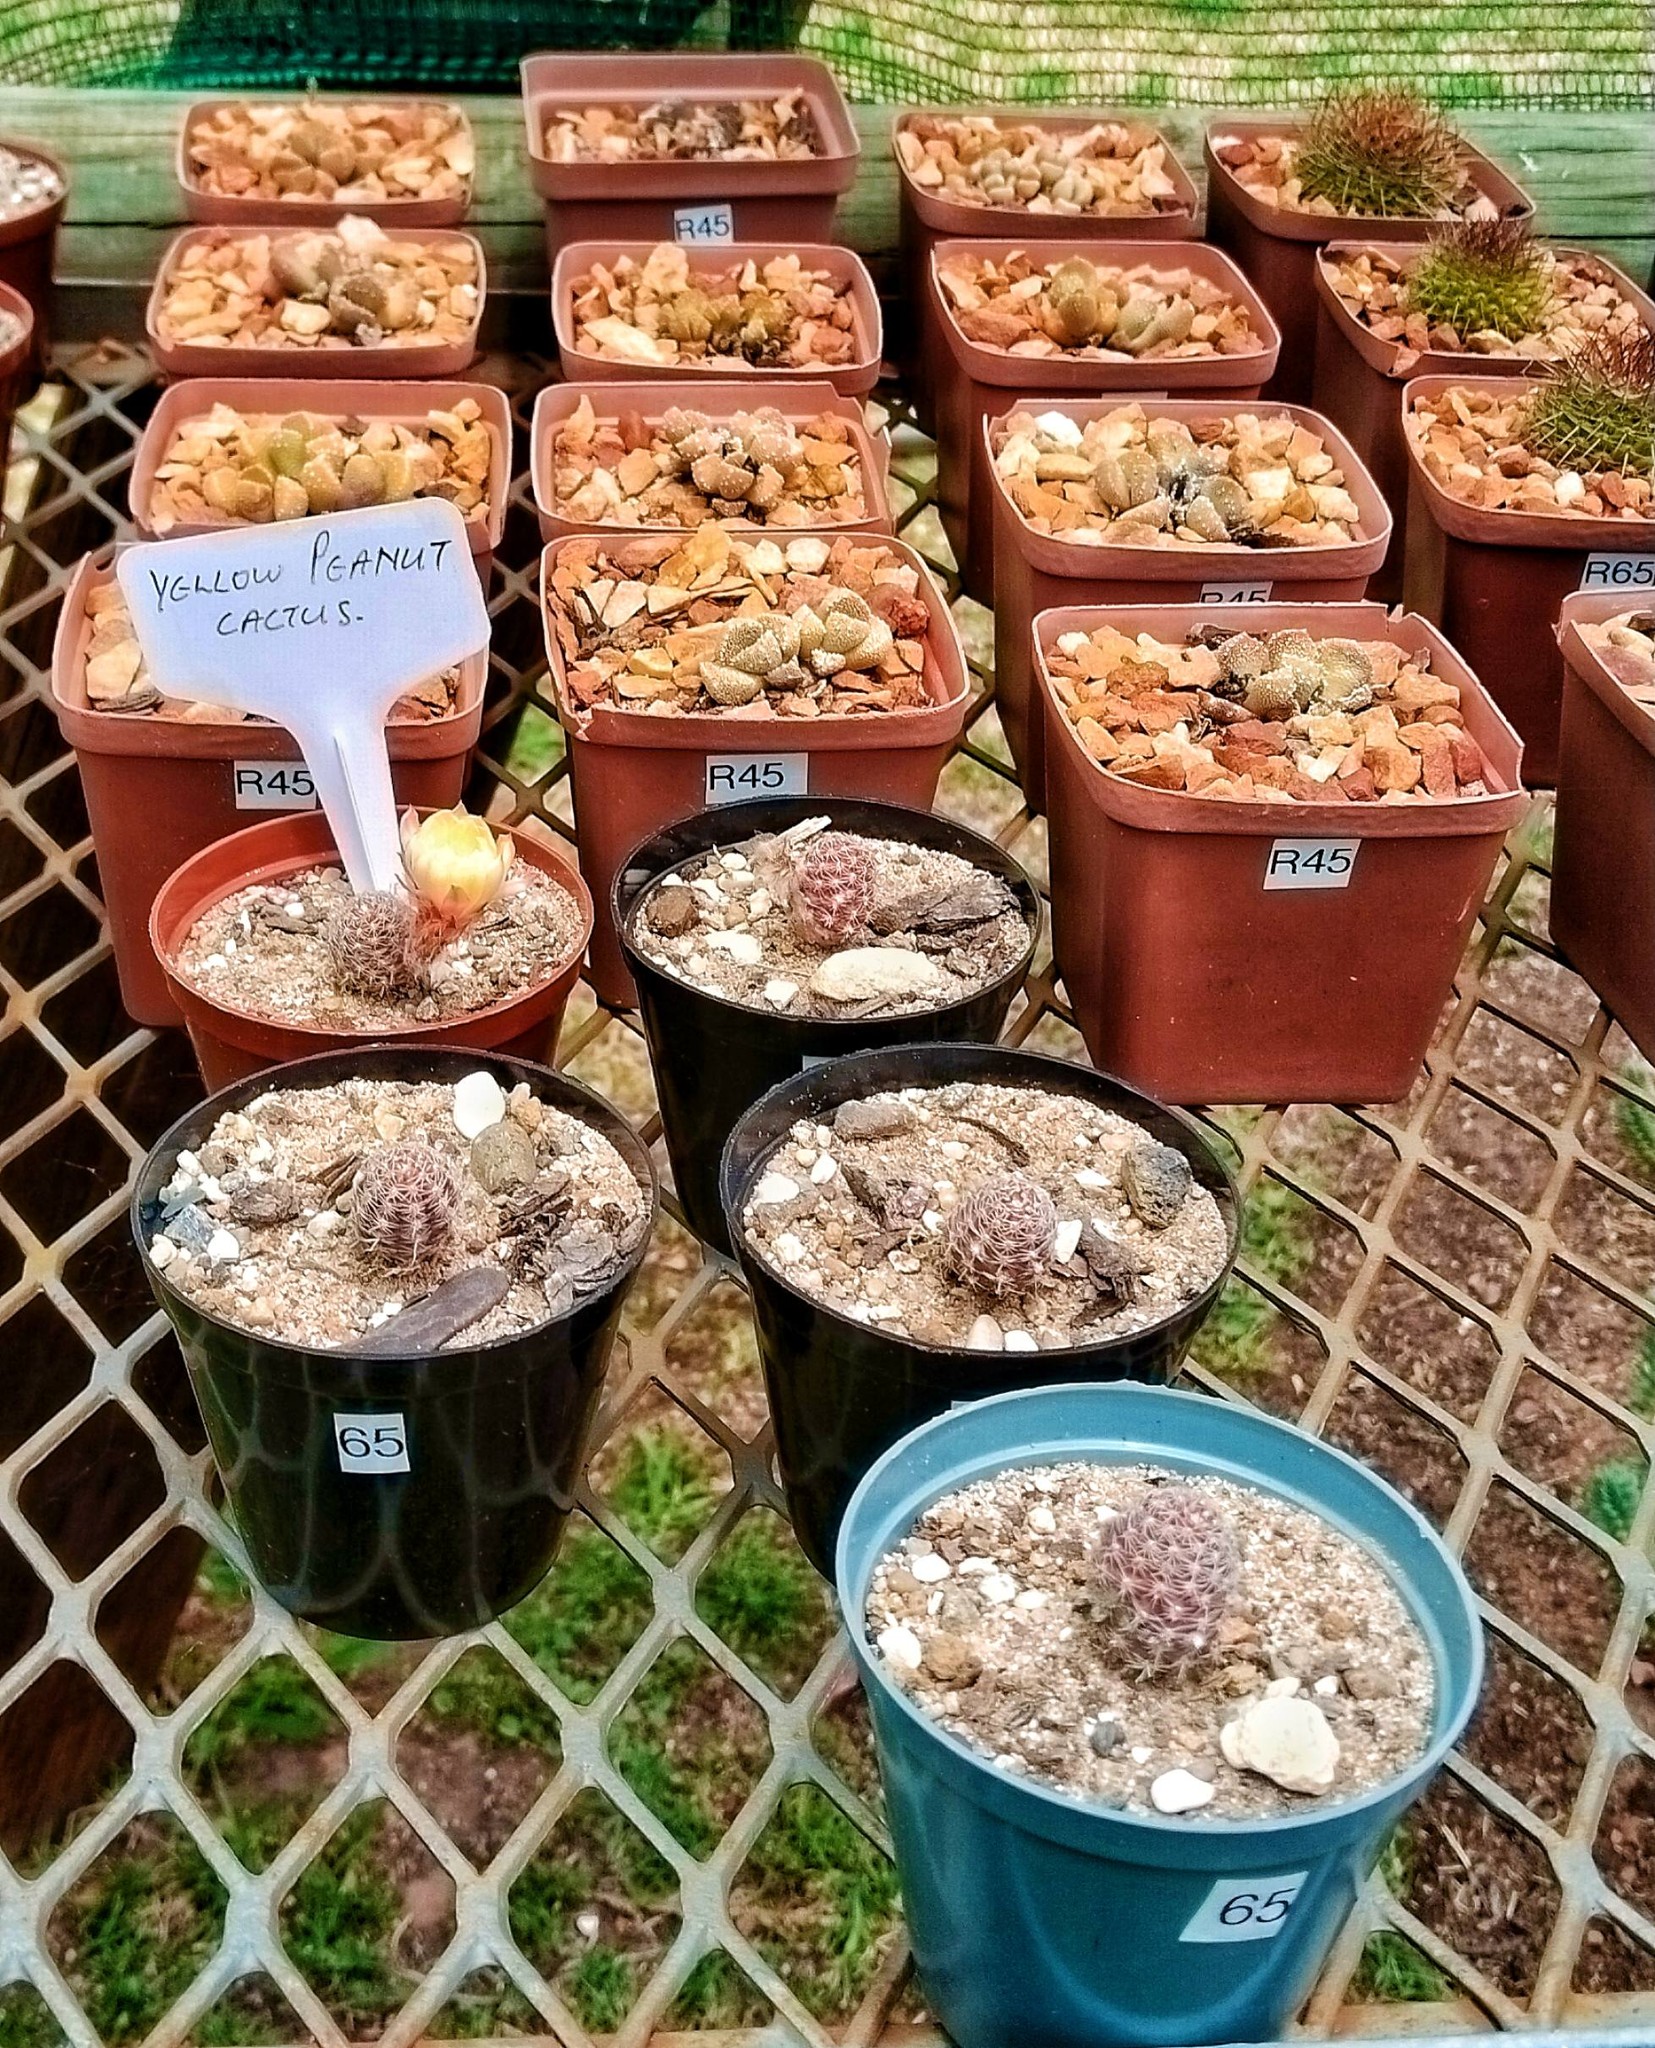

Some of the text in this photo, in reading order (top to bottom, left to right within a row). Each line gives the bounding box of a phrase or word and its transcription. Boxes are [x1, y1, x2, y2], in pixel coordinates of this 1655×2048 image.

[676, 214, 730, 239] R45
[149, 530, 453, 613] YELLOW PEANUT
[1585, 560, 1654, 585] R65
[216, 599, 364, 636] CACTUS.
[236, 769, 315, 796] R45
[709, 762, 784, 791] R45
[1270, 848, 1353, 875] R45
[339, 1426, 404, 1458] 65
[1219, 1887, 1297, 1925] 65
